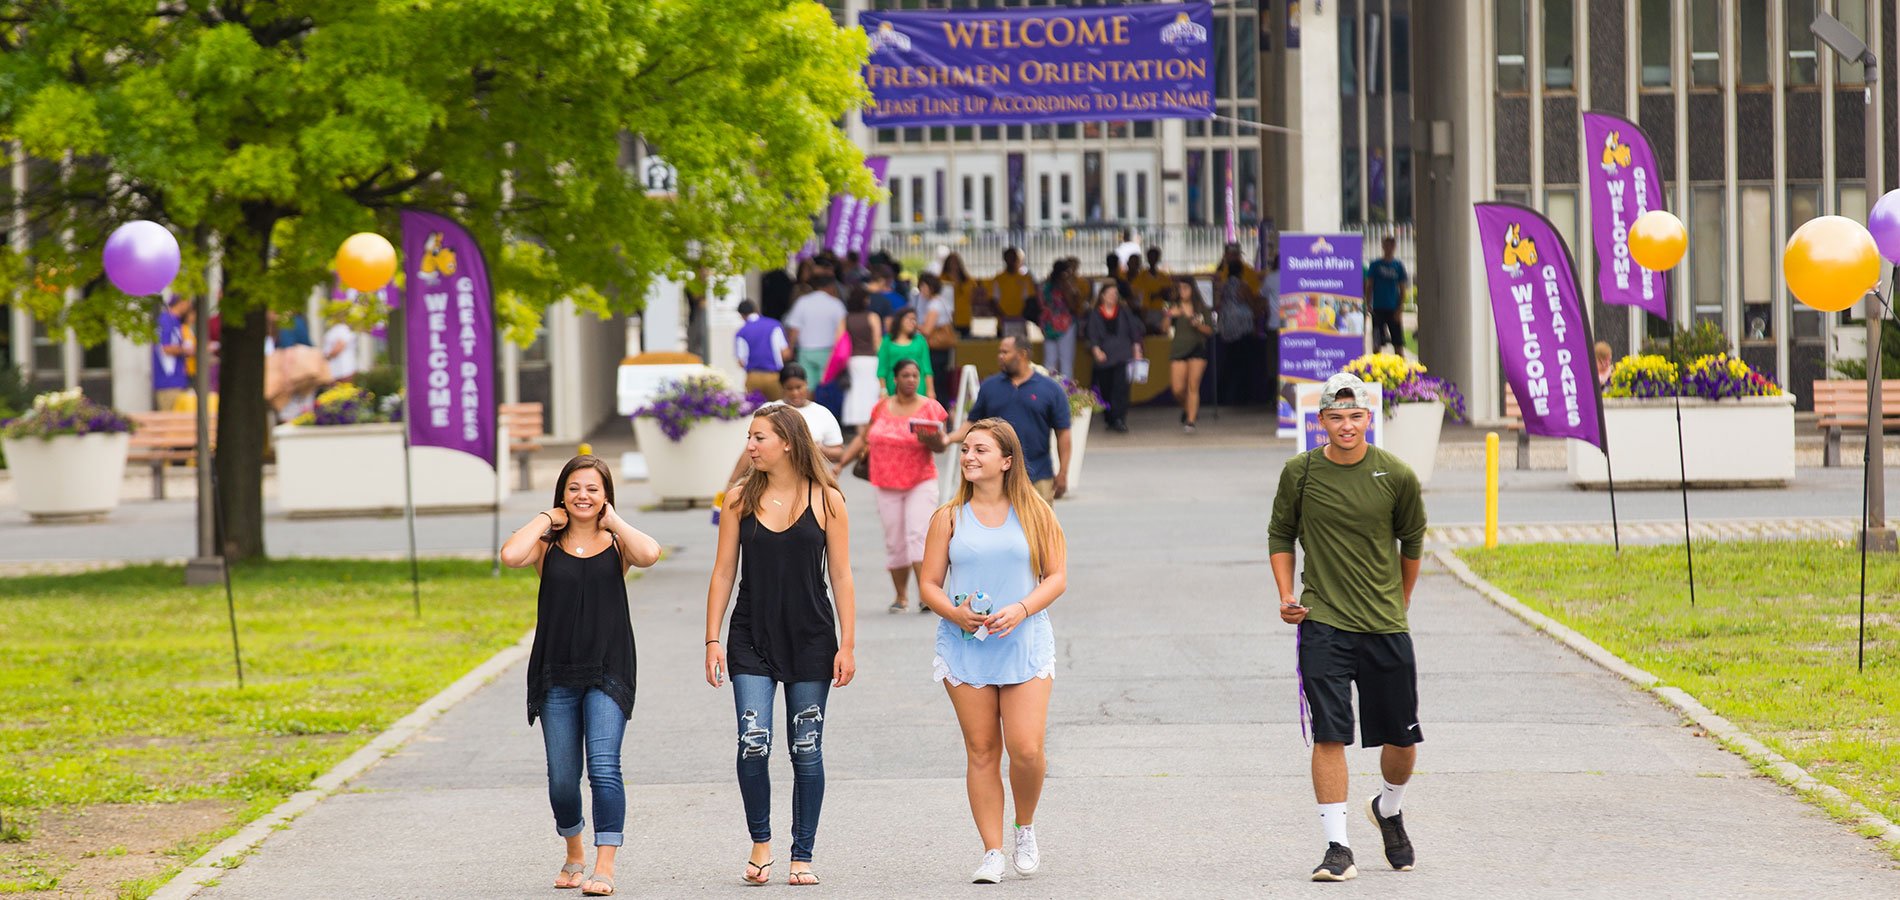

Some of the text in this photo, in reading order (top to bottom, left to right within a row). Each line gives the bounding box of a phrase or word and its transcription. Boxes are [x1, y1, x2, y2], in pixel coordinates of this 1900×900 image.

[943, 15, 1131, 49] WELCOME
[867, 58, 1207, 88] FRESHMEN ORIENTATION
[1633, 166, 1648, 219] GREA
[1287, 255, 1355, 271] Student Affairs
[1607, 180, 1630, 290] WELCOME
[1298, 277, 1344, 290] Orientation
[424, 292, 451, 428] WELCOME
[456, 276, 479, 442] GREAT DANES
[1511, 282, 1550, 417] WELCOME
[1542, 264, 1582, 428] GREAT DANES
